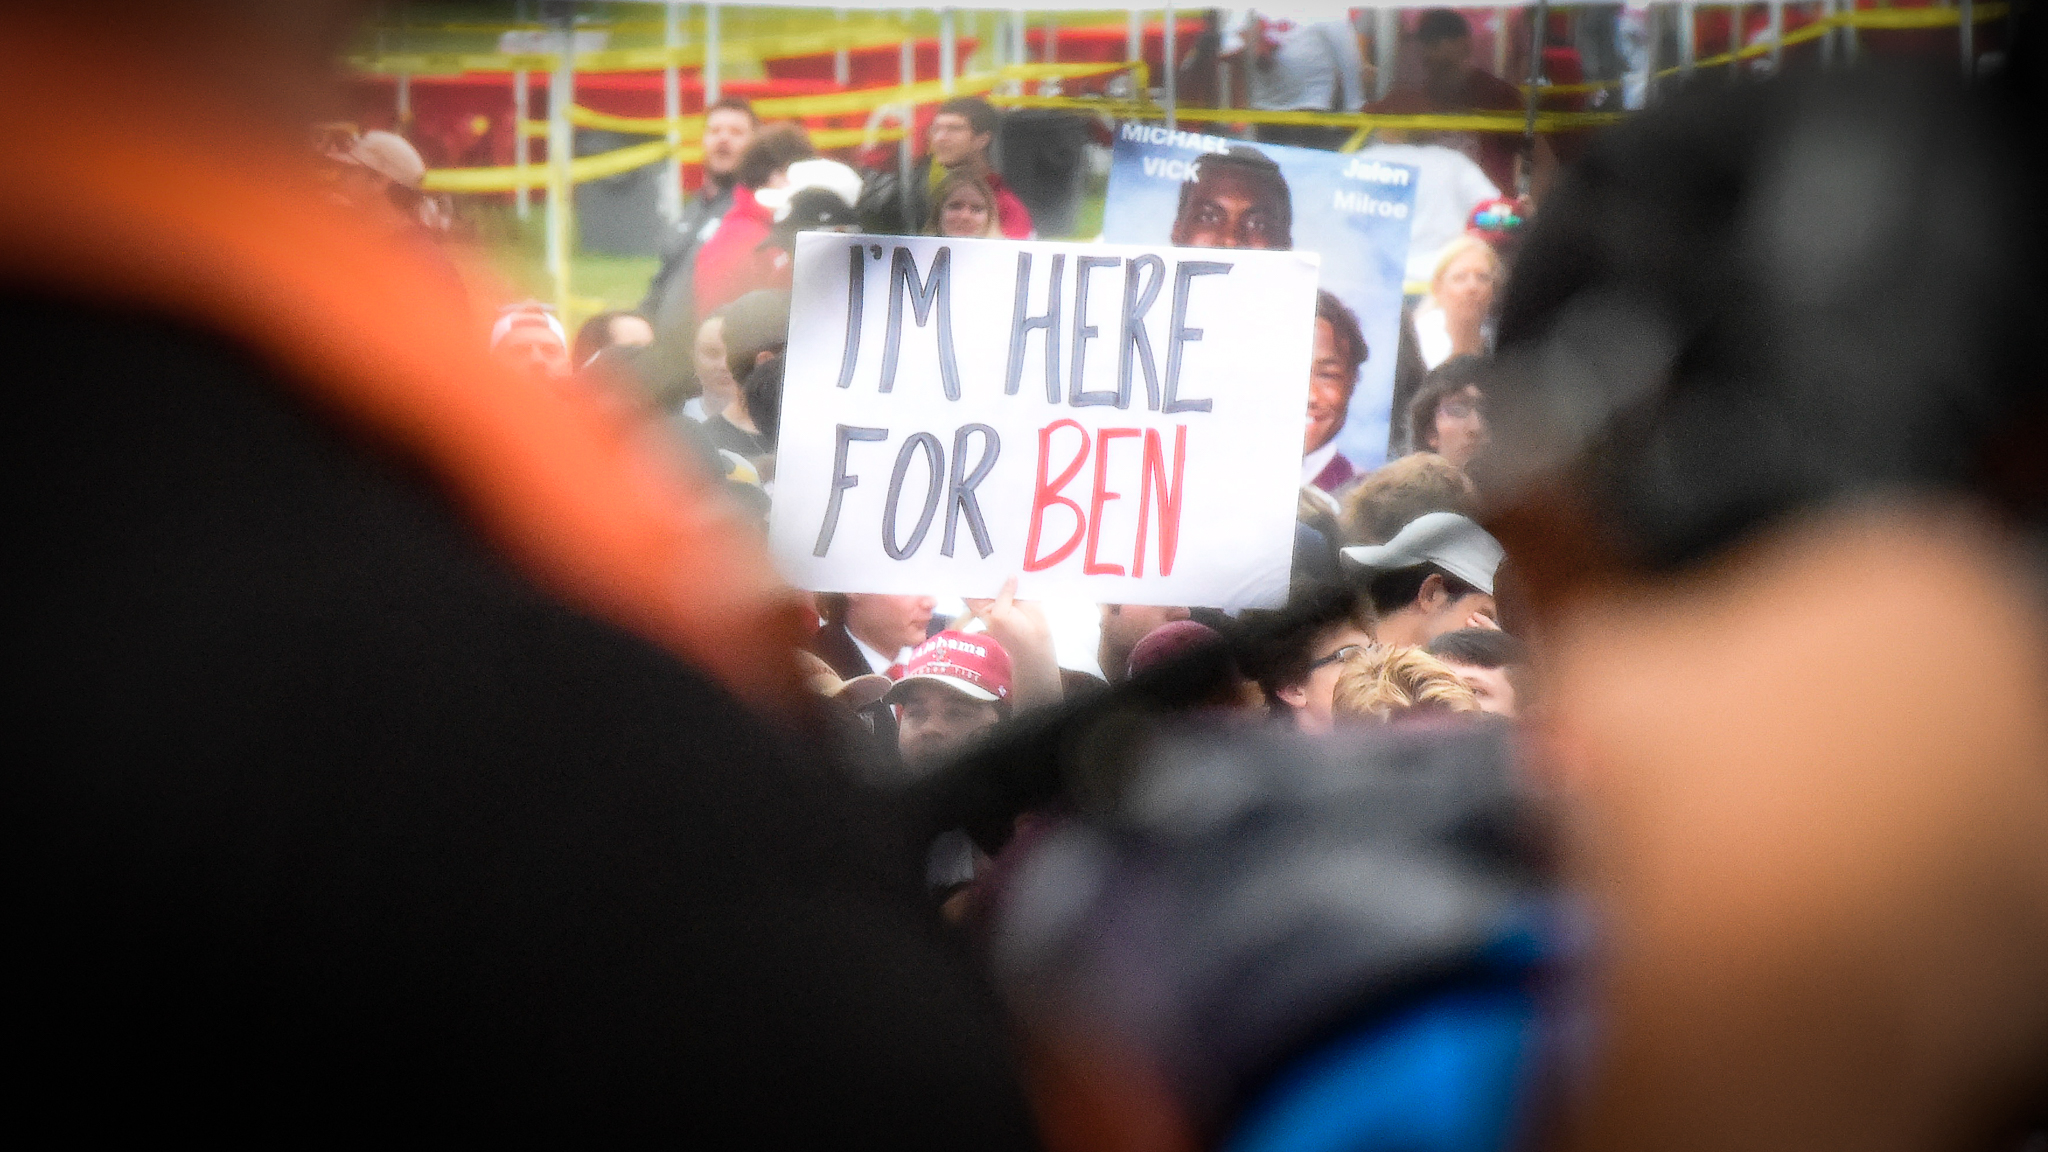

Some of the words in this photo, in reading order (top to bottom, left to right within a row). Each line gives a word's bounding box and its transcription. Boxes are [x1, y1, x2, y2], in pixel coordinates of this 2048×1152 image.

[1121, 123, 1230, 155] MICHAEL
[1143, 156, 1201, 183] VICK
[1343, 158, 1409, 187] Jalen
[1333, 189, 1409, 219] Milroe
[837, 245, 961, 401] I'M
[1004, 252, 1234, 414] HERE
[813, 423, 1000, 561] FOR
[1023, 418, 1187, 578] BEN
